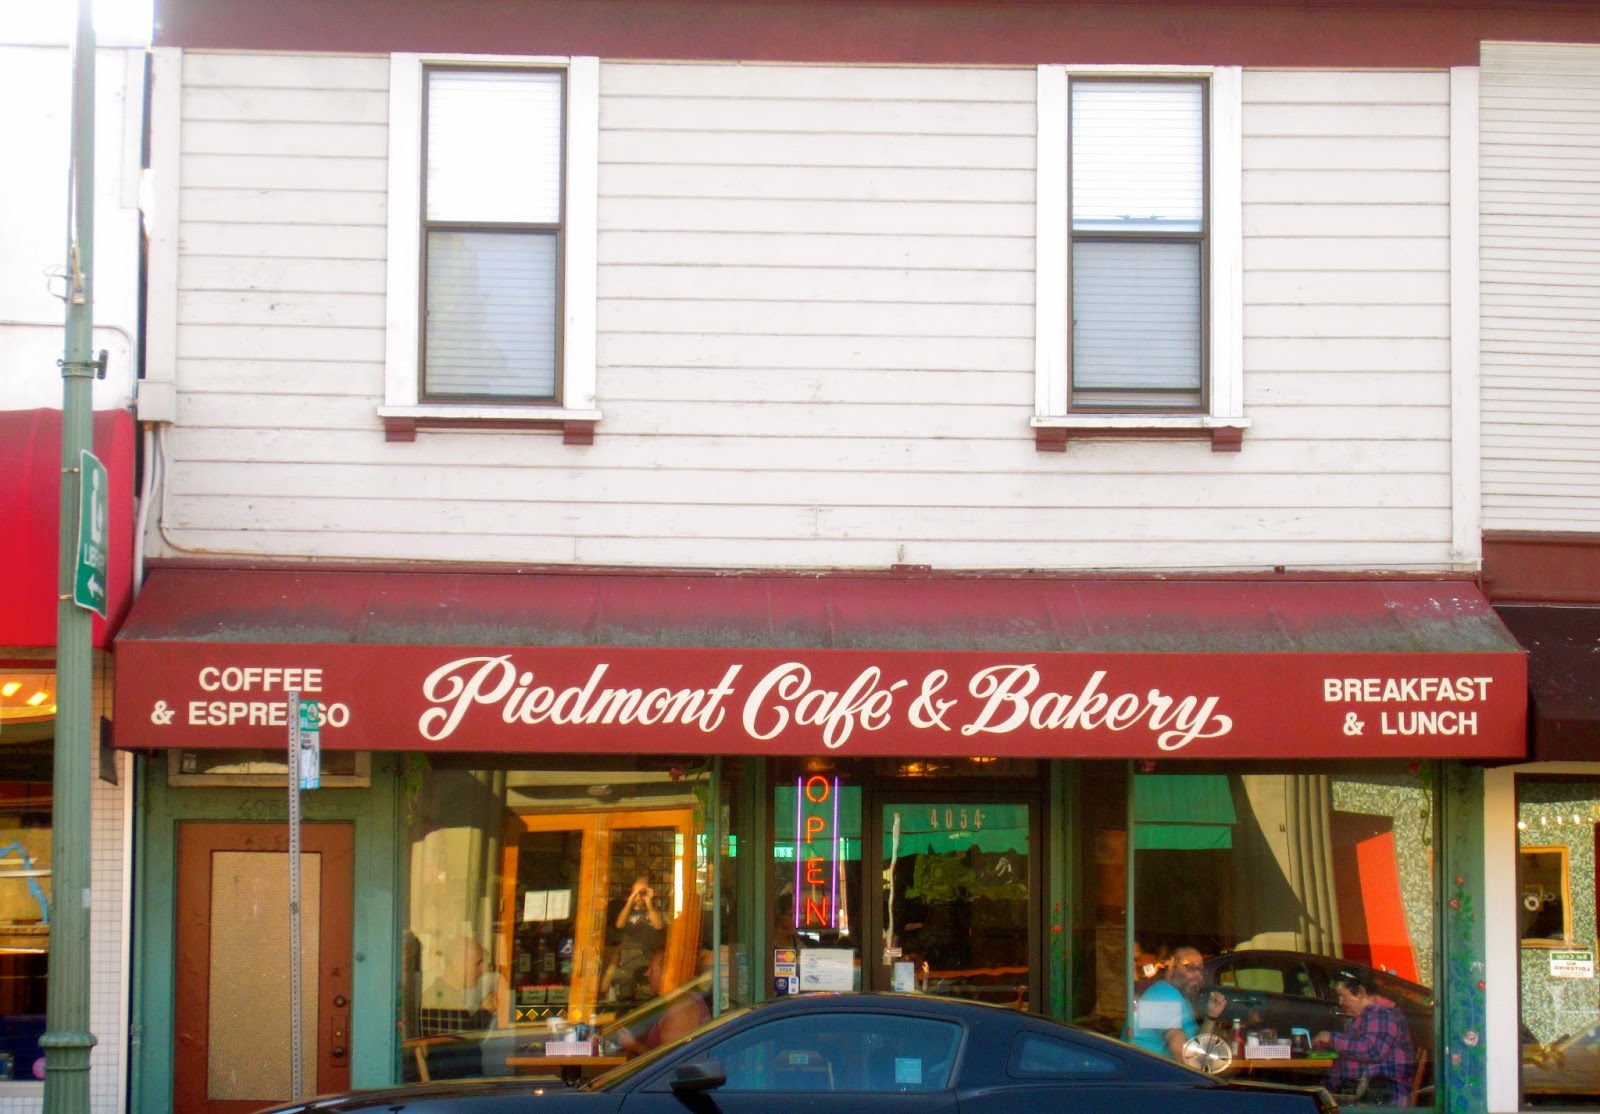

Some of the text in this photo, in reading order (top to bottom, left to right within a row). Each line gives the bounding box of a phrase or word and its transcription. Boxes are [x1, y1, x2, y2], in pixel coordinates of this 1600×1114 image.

[199, 666, 323, 692] COFFEE
[1323, 676, 1493, 702] BREAKFAST
[150, 700, 350, 727] & ESPREO
[418, 654, 1233, 751] Piedmont Café & Bakery
[1342, 710, 1478, 736] & LUNCH
[805, 775, 831, 926] OPEN
